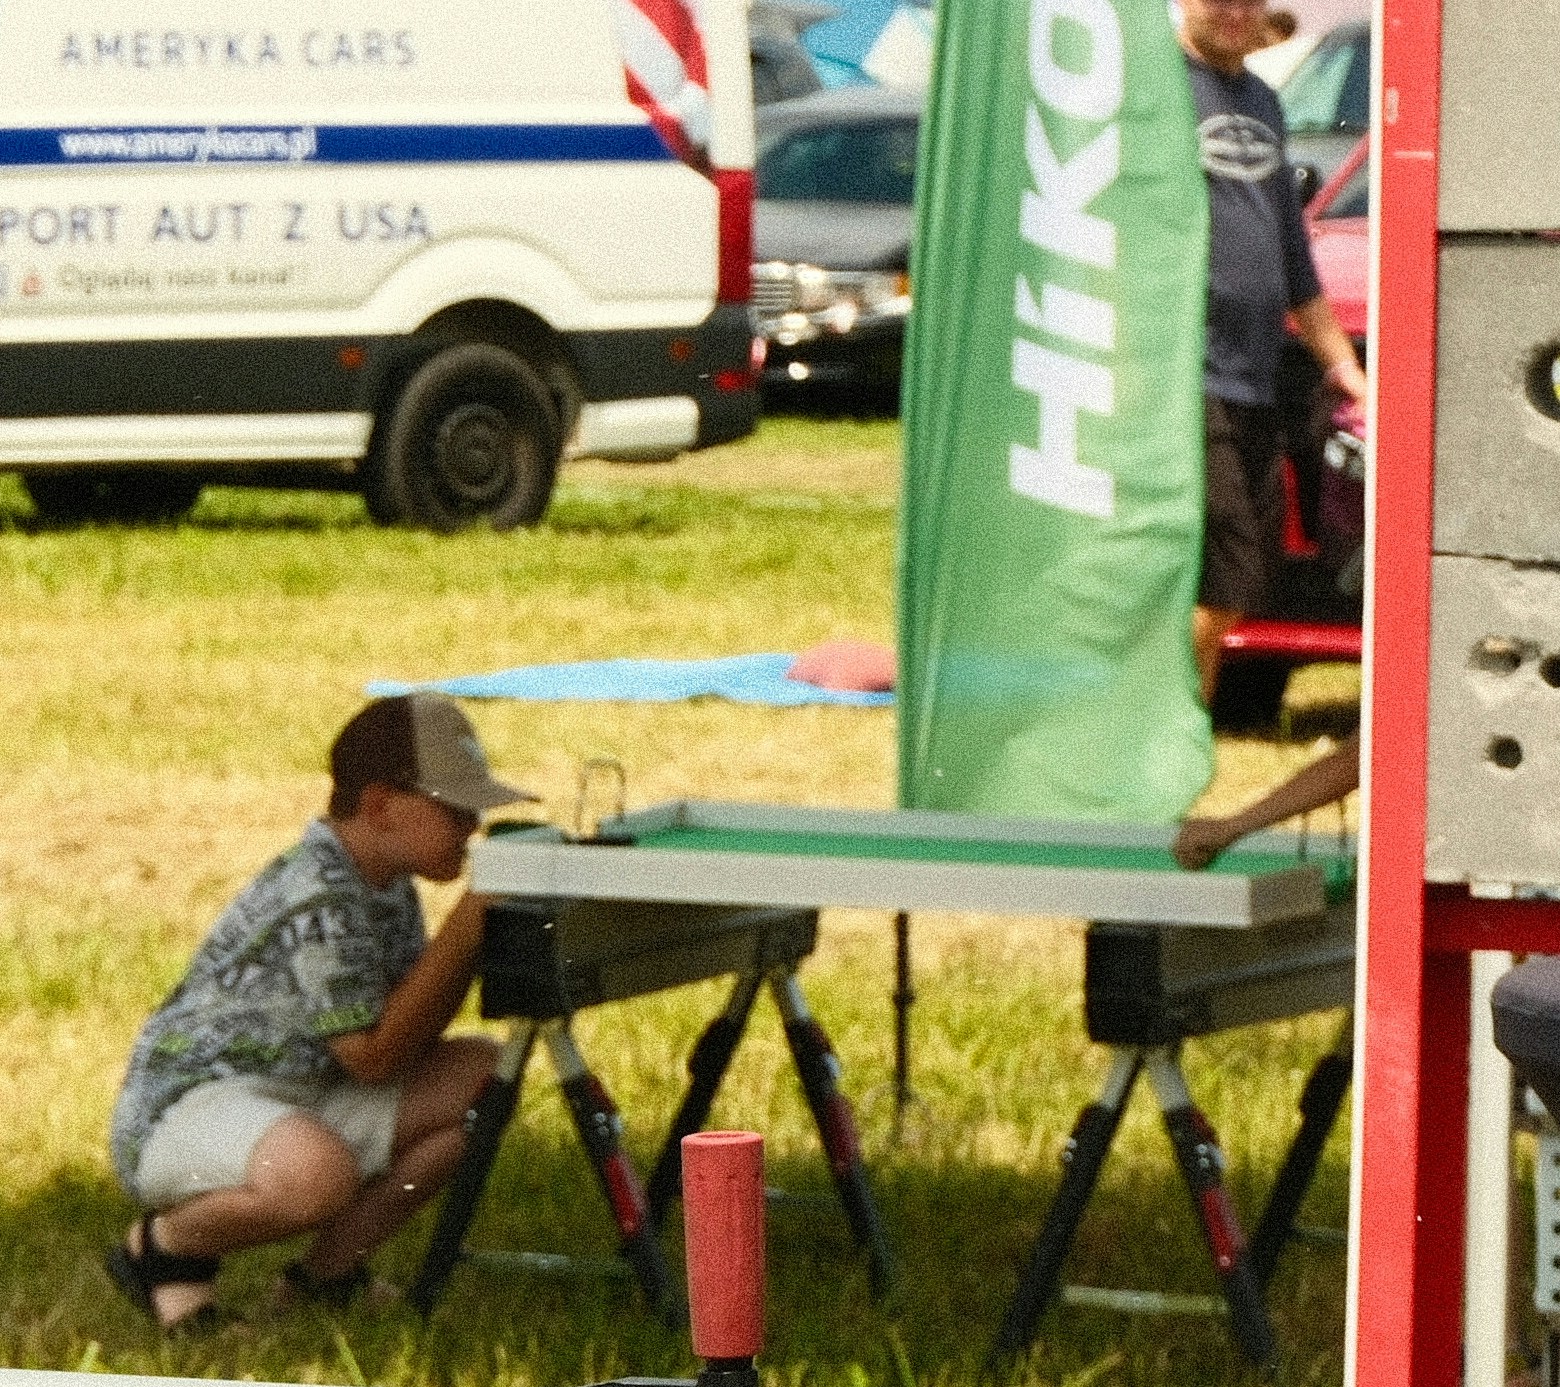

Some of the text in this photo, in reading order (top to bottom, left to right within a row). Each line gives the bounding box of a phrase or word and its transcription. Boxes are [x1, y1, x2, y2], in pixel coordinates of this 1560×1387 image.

[61, 30, 418, 68] AMERYKA CARS
[153, 204, 253, 243] AUT
[285, 202, 308, 242] Z
[336, 202, 434, 242] USA
